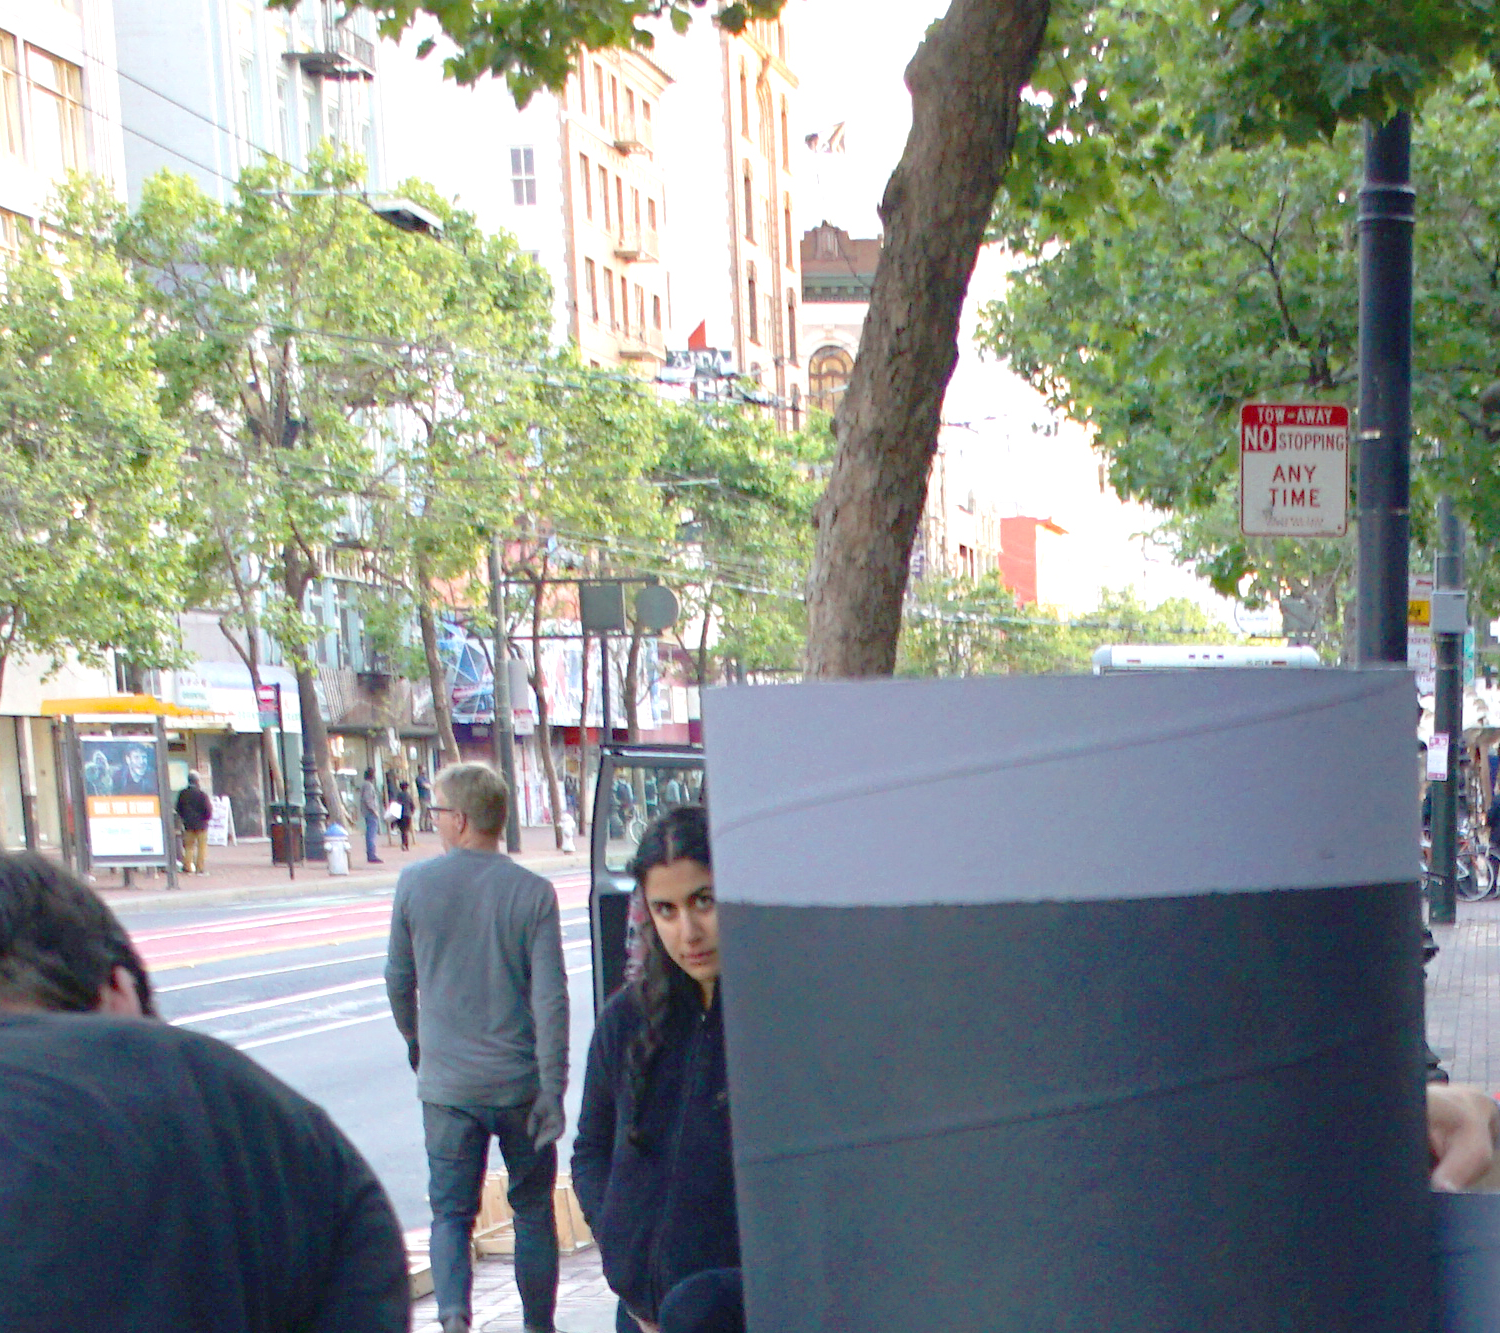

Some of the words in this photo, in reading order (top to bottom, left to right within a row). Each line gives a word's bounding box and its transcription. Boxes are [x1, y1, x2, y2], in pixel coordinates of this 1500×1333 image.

[1244, 425, 1274, 450] NO
[1278, 433, 1344, 451] STOPPING
[1272, 464, 1316, 483] ANY
[1269, 488, 1321, 508] TIME
